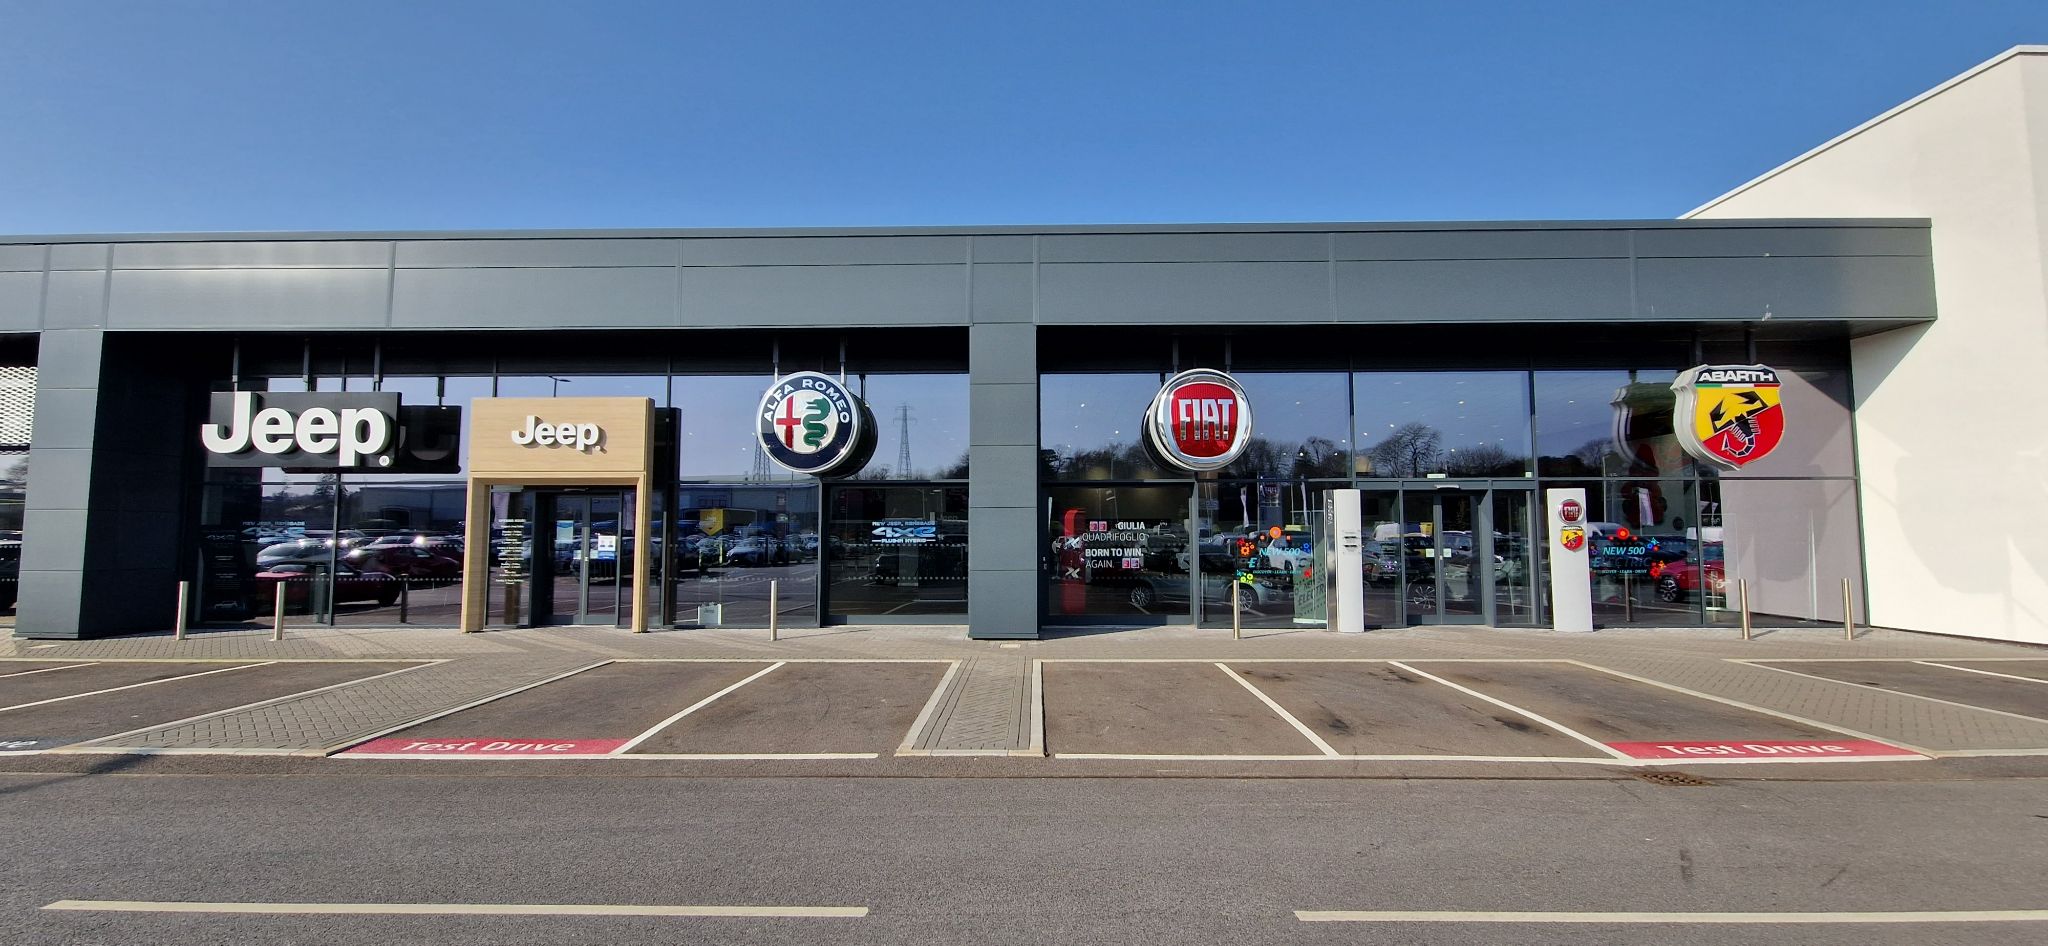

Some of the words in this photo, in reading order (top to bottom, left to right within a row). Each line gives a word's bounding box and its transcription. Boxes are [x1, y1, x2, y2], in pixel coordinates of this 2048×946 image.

[1699, 370, 1773, 382] ABARTH
[763, 384, 795, 422] ALFA
[802, 379, 850, 423] ROMEO
[1178, 399, 1233, 440] FIAT
[202, 391, 390, 466] Jeep
[511, 415, 599, 450] Jeep
[1118, 521, 1146, 530] GIULIA
[1082, 532, 1146, 542] QUADRIFOGLIO
[1085, 548, 1109, 557] BORN
[1111, 548, 1122, 557] TO
[1603, 547, 1626, 555] NEW
[1627, 547, 1645, 555] 500
[401, 742, 476, 750] Test
[480, 742, 575, 751] Drive
[1657, 744, 1746, 755] Test
[1744, 744, 1852, 754] Drive
